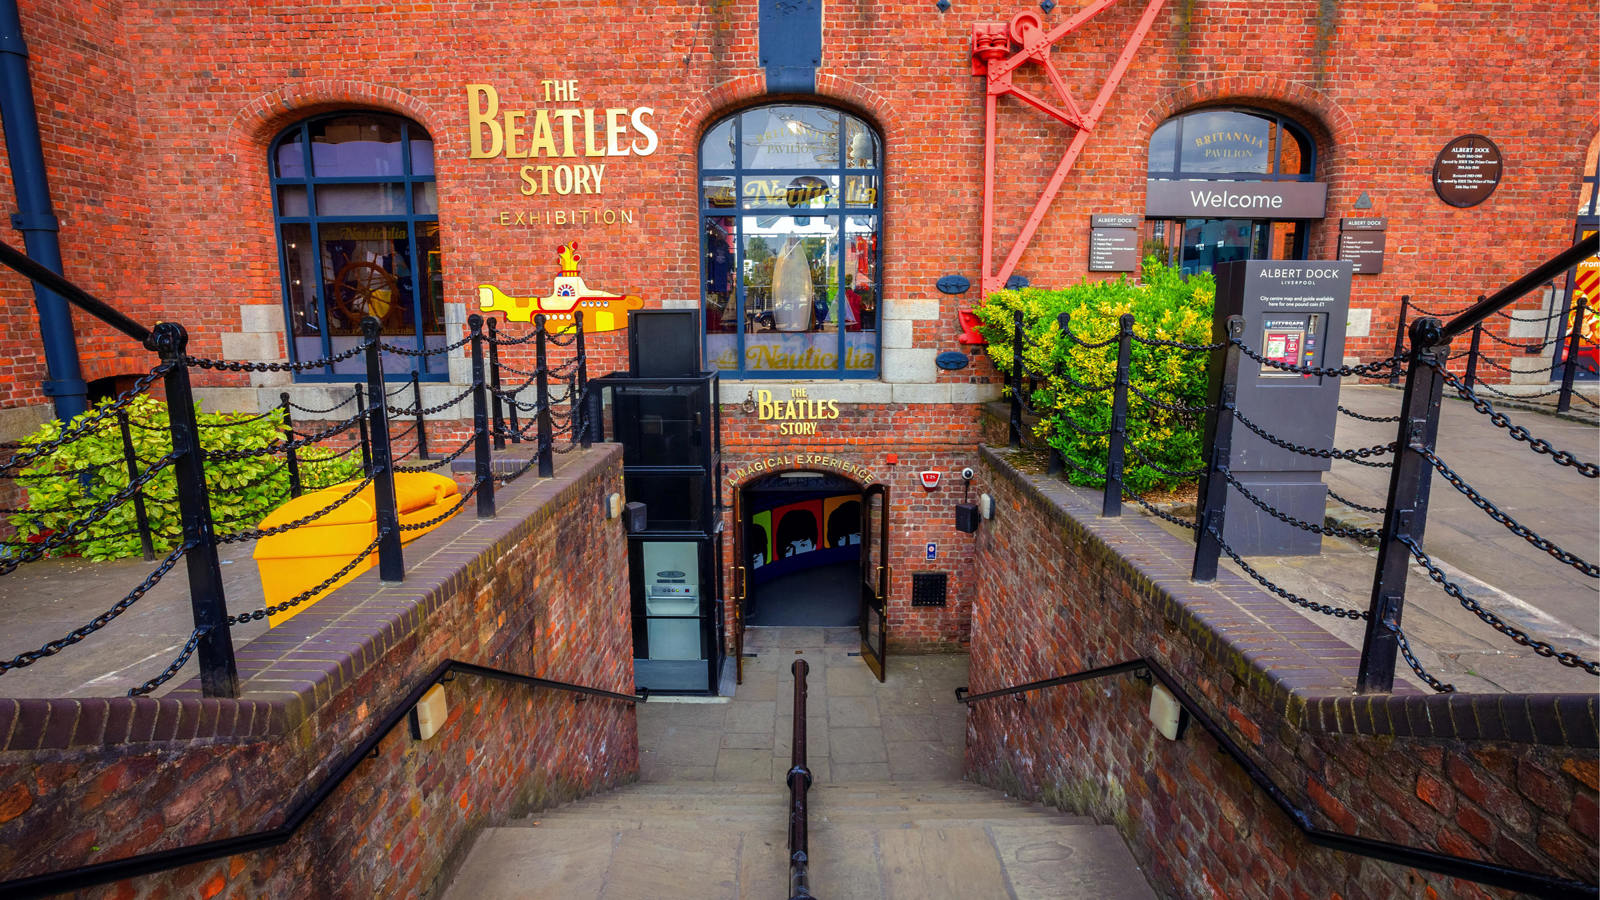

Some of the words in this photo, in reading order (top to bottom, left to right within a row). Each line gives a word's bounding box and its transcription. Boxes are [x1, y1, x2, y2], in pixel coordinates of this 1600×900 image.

[541, 79, 580, 102] THE
[466, 84, 658, 158] BEATLES
[1195, 132, 1262, 148] BRITANNIA
[1204, 148, 1253, 158] PAVILION
[520, 164, 605, 196] STORY
[1190, 190, 1282, 208] Welcome
[500, 210, 633, 226] EXHIBITION
[1260, 269, 1302, 278] ALBERT
[1306, 269, 1340, 279] DOCK
[790, 388, 808, 398] THE
[758, 390, 840, 420] BEATLES
[780, 422, 817, 435] STORY
[728, 478, 737, 486] A
[736, 455, 792, 479] MAGICAL
[797, 455, 874, 484] EXPERIENCE
